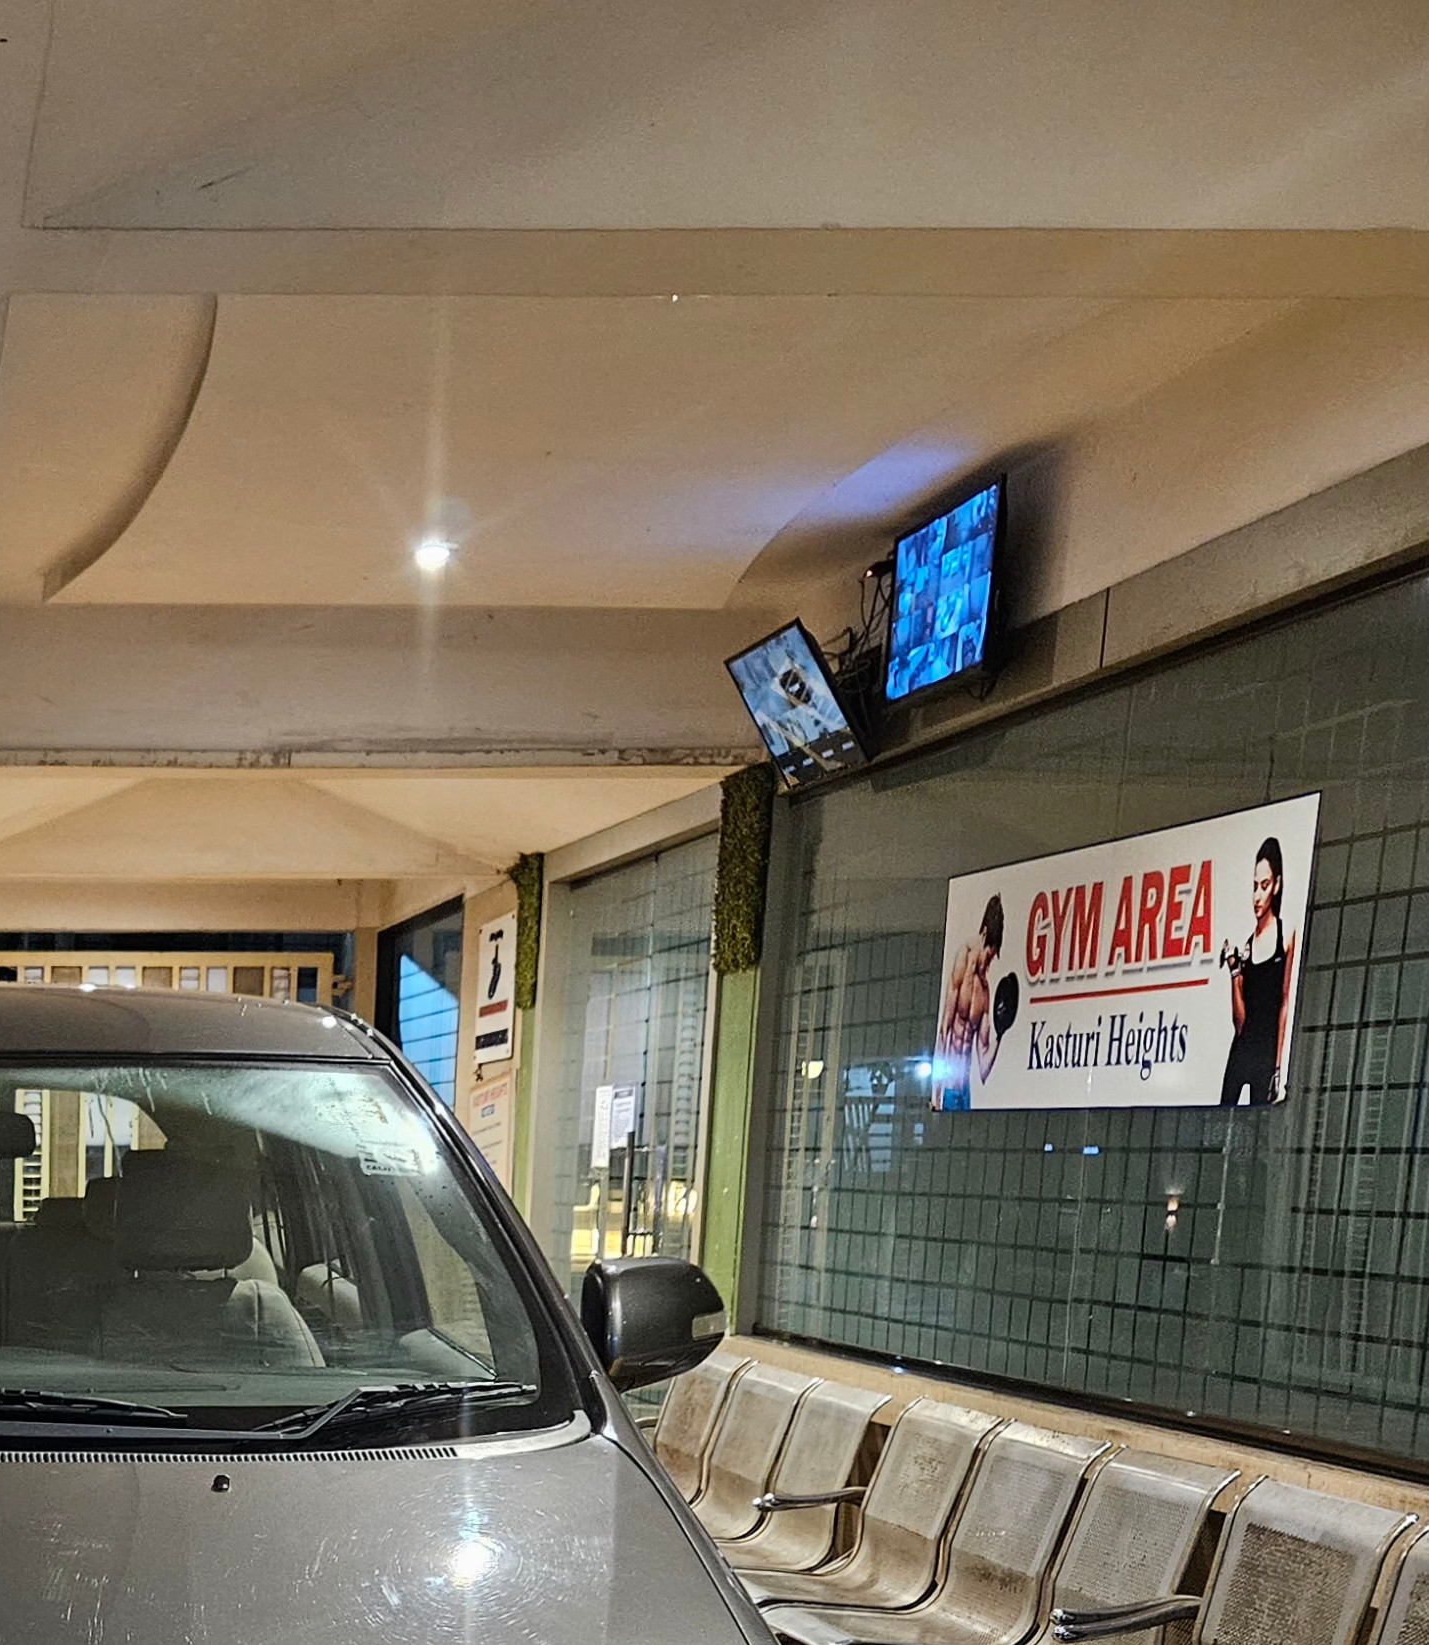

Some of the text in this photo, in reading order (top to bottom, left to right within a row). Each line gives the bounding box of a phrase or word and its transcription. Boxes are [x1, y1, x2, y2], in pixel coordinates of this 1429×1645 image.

[1025, 859, 1213, 979] GYM AREA
[1026, 1010, 1189, 1081] Kasturi Heights
